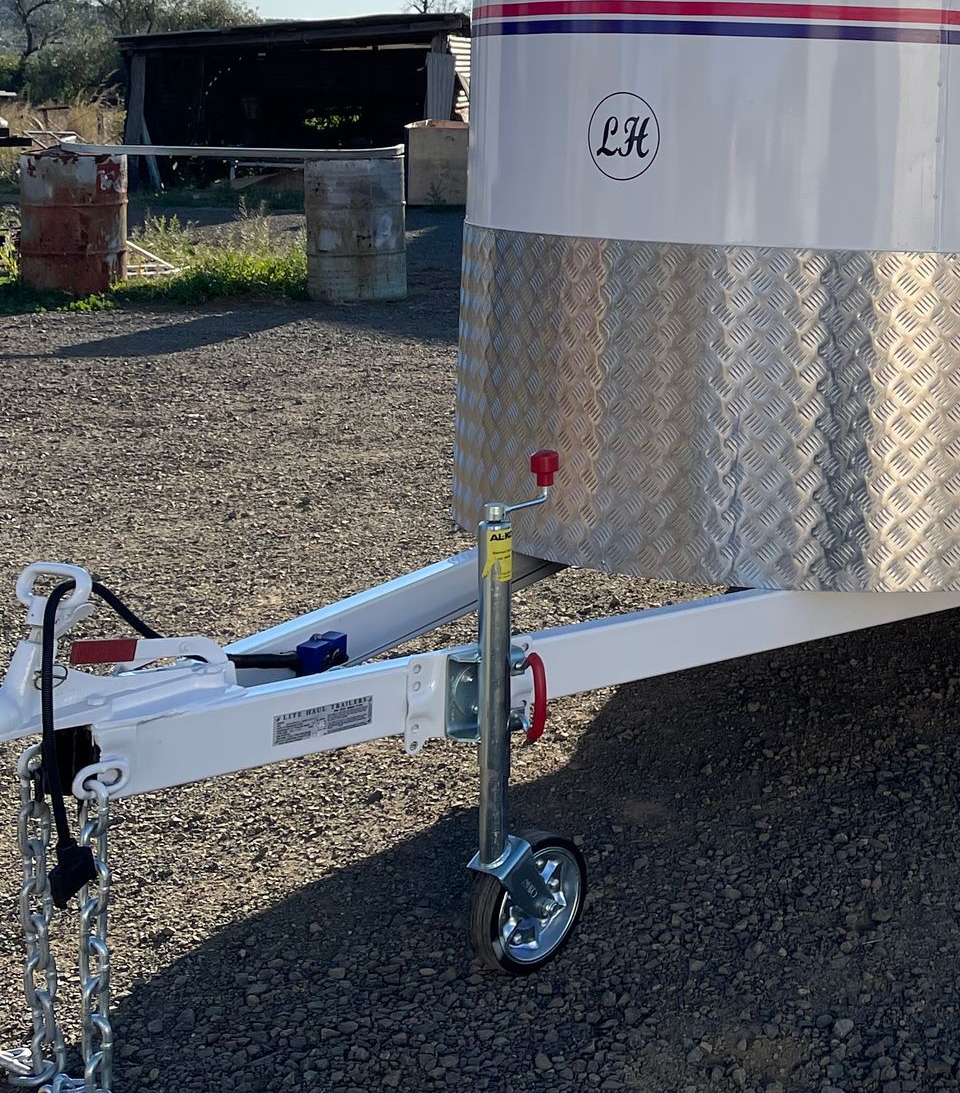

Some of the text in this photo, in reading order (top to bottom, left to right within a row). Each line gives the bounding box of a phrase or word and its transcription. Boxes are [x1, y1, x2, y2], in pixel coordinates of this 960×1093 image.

[596, 116, 650, 158] LH
[282, 697, 367, 721] LITE HAUL TRAILERS
